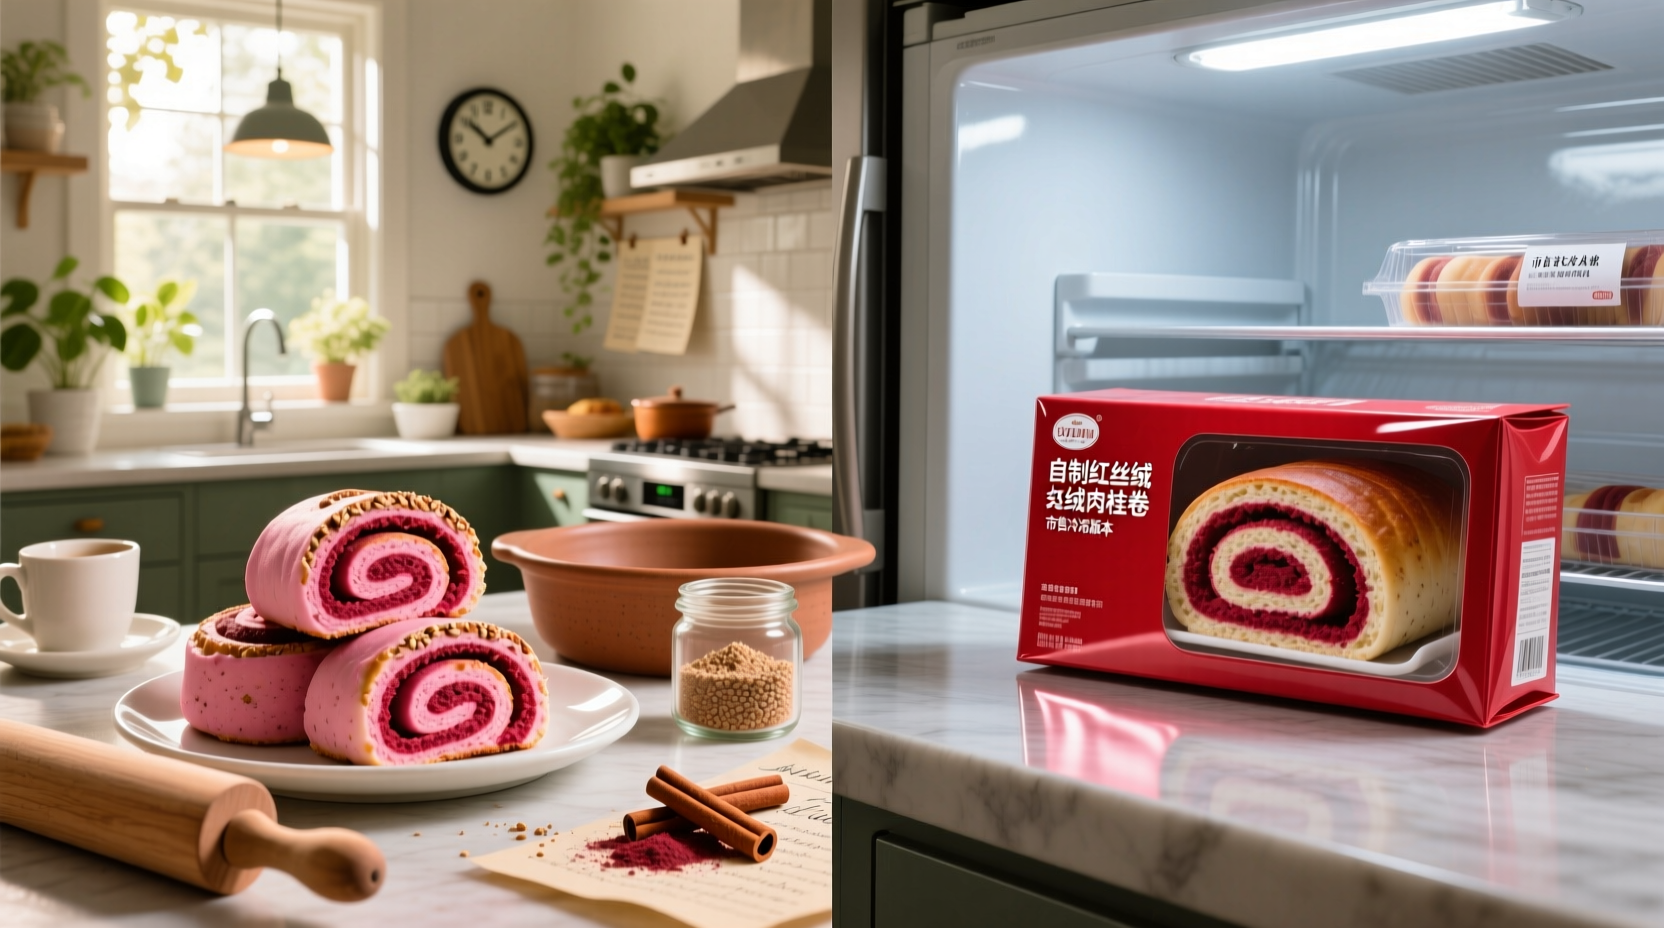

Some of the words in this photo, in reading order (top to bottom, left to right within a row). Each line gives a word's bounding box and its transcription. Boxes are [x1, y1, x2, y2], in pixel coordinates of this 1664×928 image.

[1049, 458, 1152, 488] 自制红丝绒
